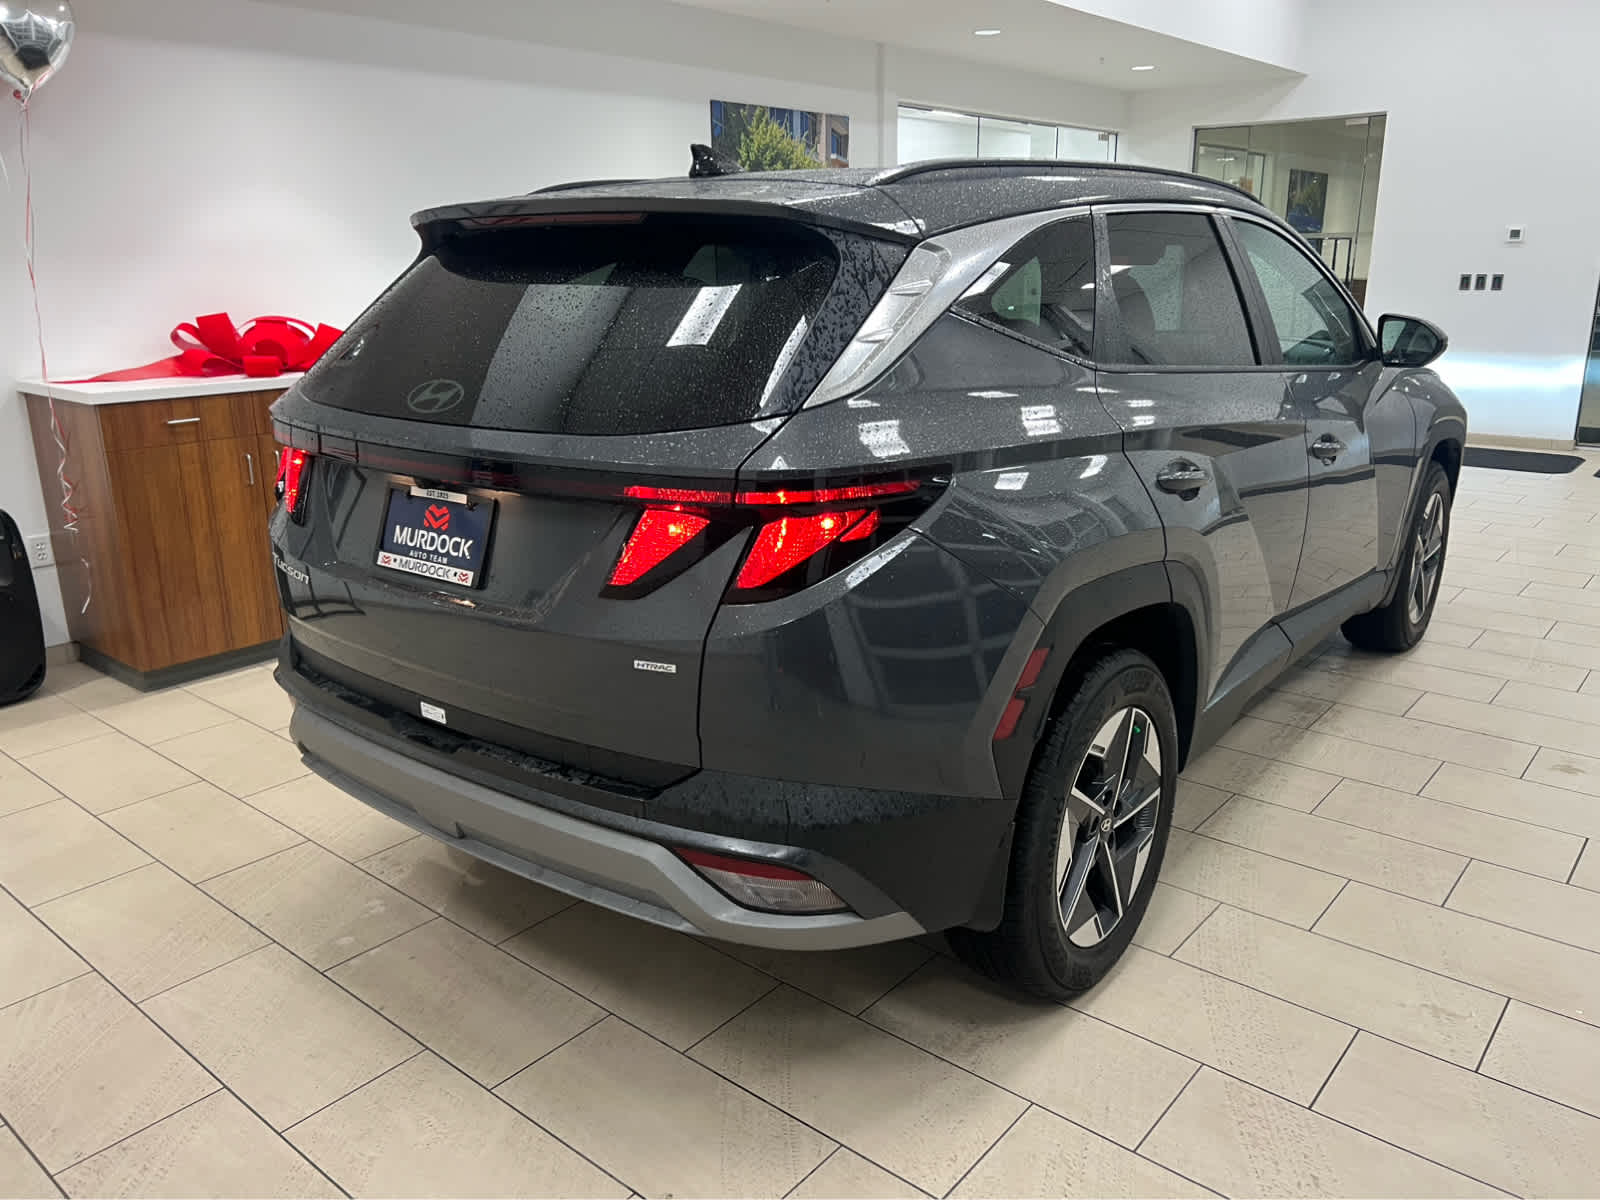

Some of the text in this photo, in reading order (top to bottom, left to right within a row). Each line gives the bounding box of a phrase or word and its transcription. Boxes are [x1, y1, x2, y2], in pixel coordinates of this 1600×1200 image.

[393, 525, 473, 559] MURDOCK
[409, 550, 448, 564] AUTO TEAM
[398, 558, 451, 579] MURDOCK
